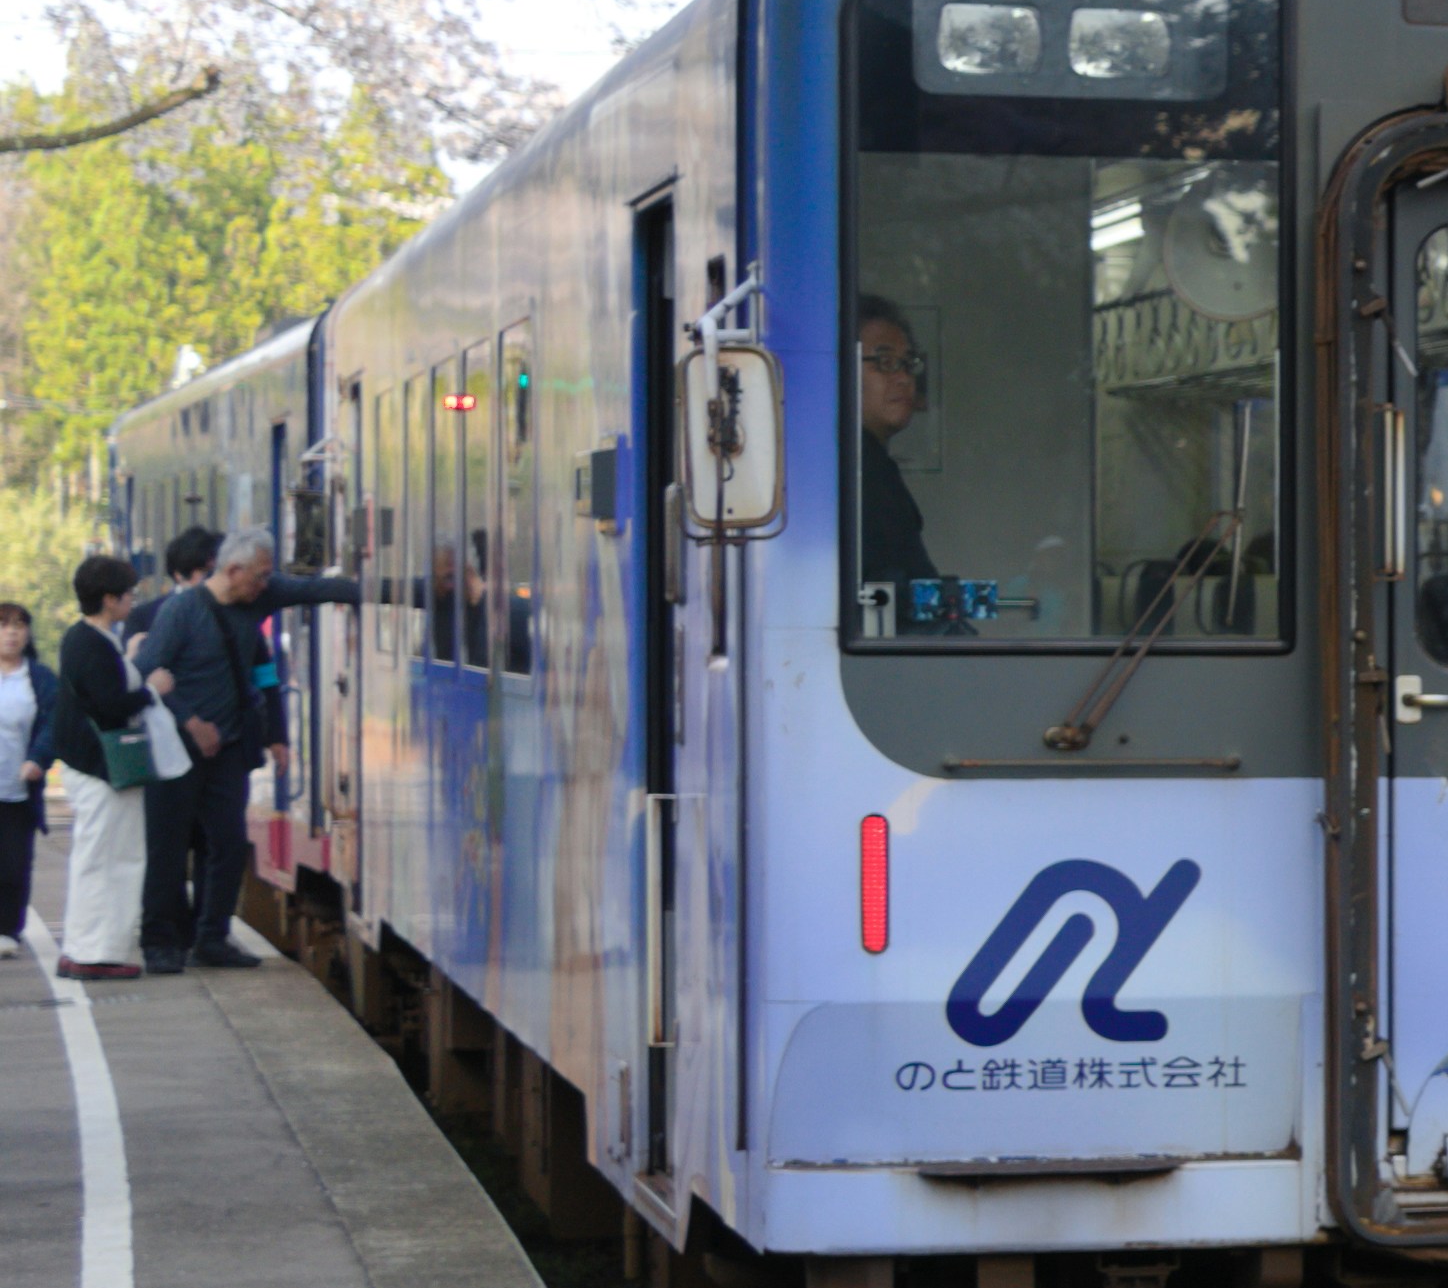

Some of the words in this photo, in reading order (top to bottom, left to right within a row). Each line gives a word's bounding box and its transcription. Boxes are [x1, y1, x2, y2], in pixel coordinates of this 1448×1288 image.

[895, 1055, 1247, 1091] のと鉄道株式会社
